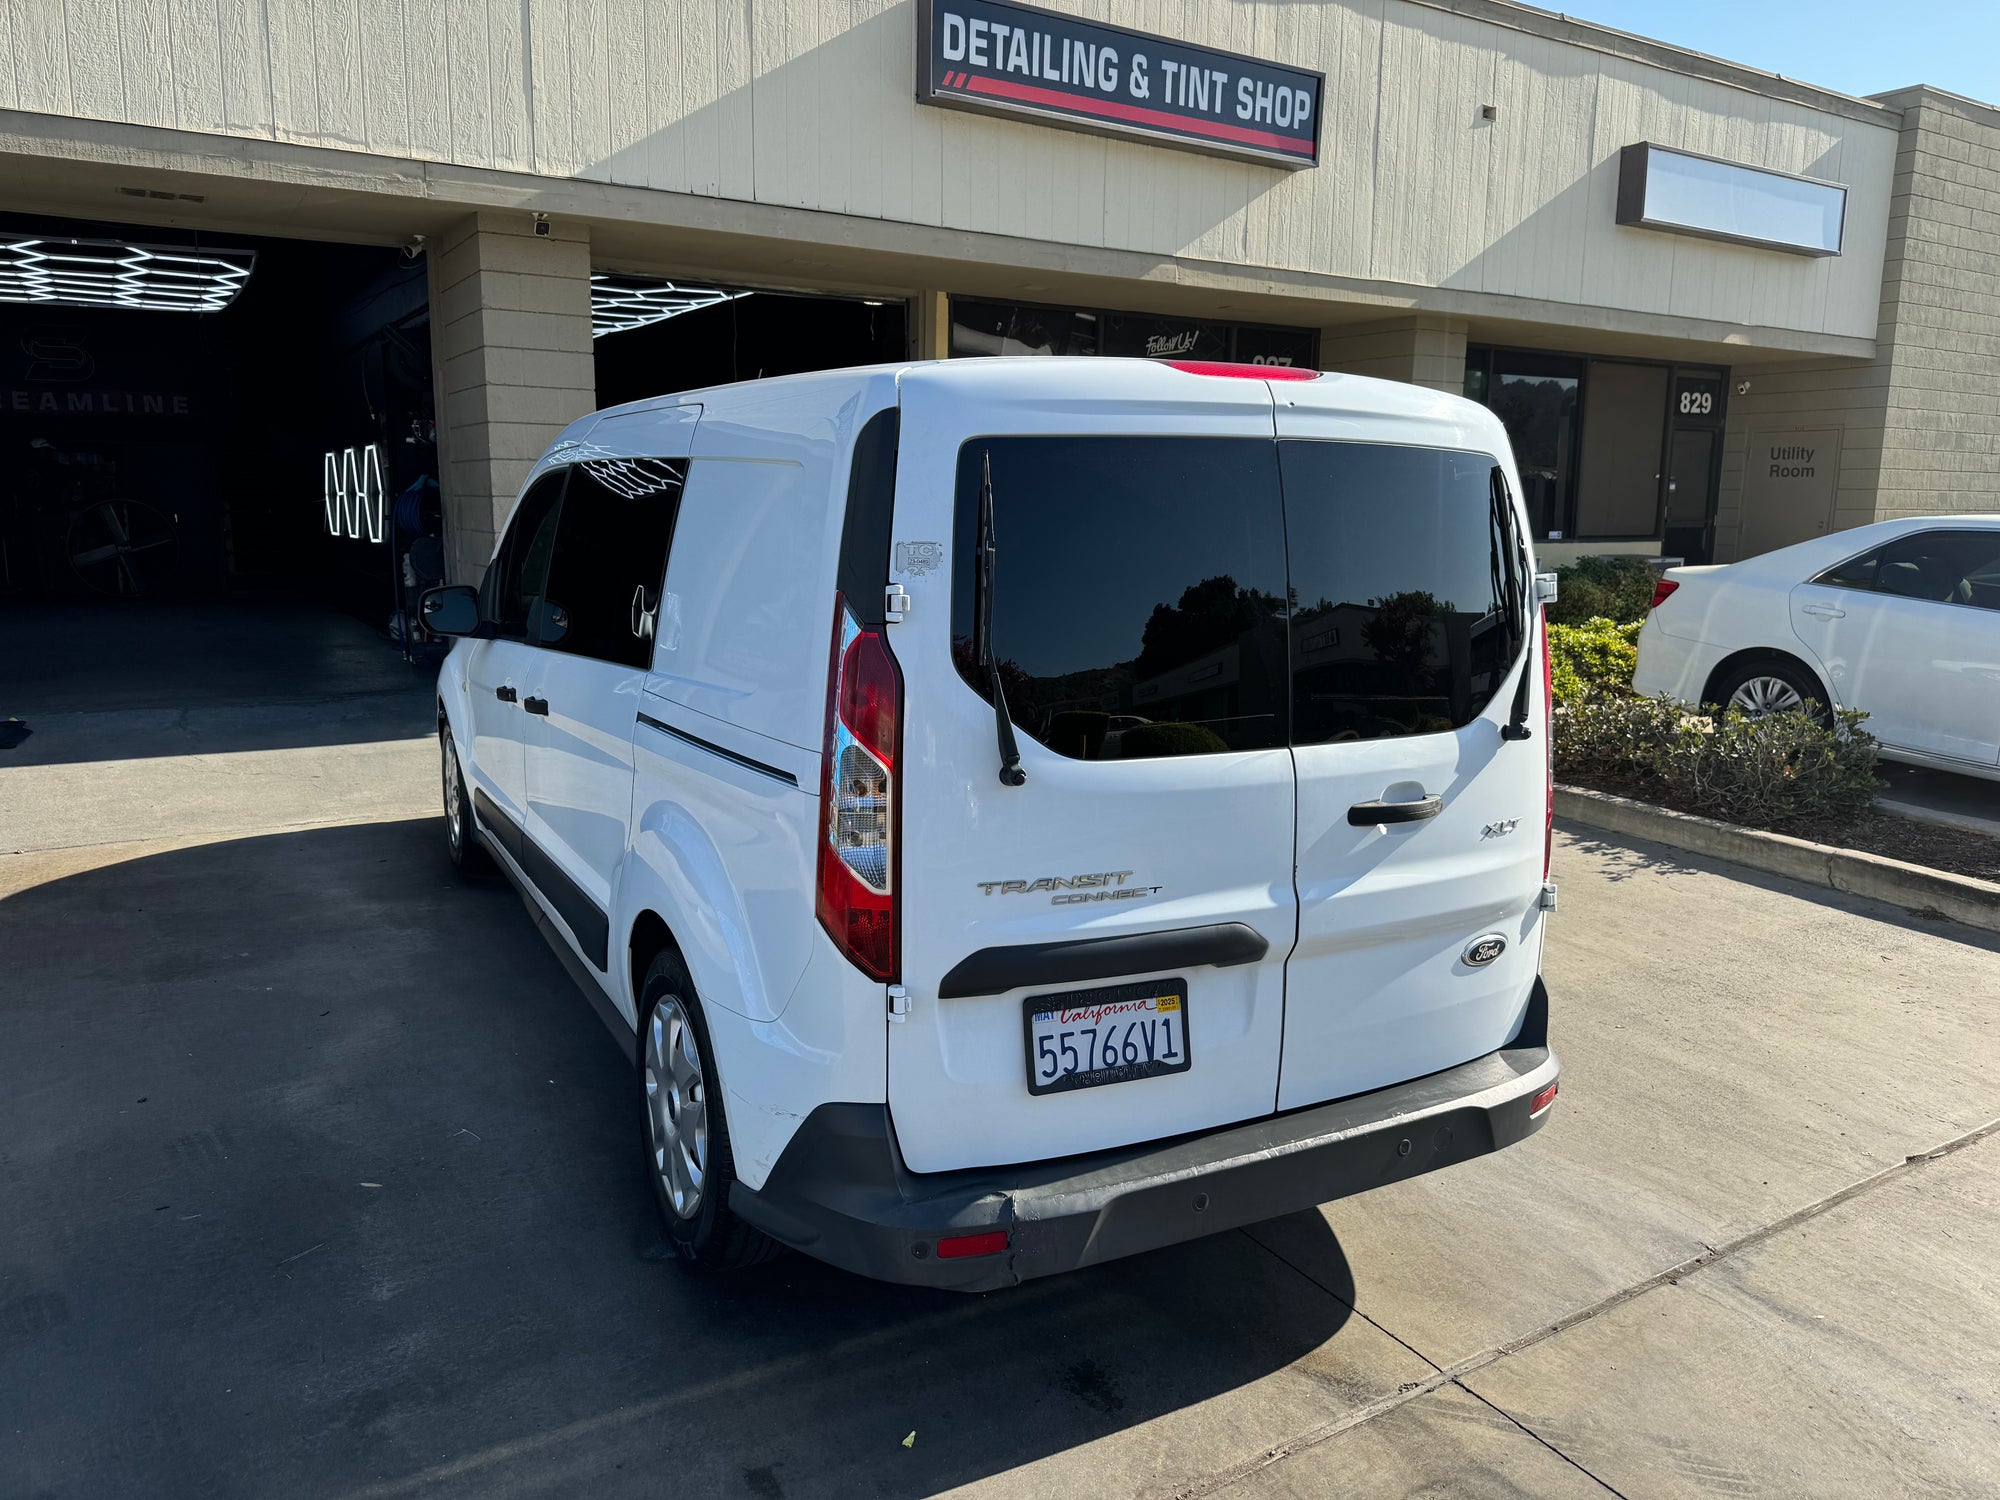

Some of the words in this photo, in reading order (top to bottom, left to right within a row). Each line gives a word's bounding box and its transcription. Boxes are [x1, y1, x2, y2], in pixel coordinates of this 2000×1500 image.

[943, 12, 1119, 93] DETAILING
[1129, 53, 1150, 99] &
[1161, 60, 1229, 114] TINT
[1236, 76, 1312, 130] SHOP
[0, 390, 190, 415] EAMLINE
[1680, 392, 1712, 414] 829
[1770, 446, 1815, 463] Utility
[1769, 464, 1815, 478] Room
[1480, 817, 1523, 842] XLT
[977, 870, 1136, 897] TRANSIT
[1051, 886, 1163, 906] CONNECT
[1475, 942, 1500, 961] Ford
[1034, 1010, 1055, 1022] MAY
[1060, 999, 1157, 1026] California
[1161, 997, 1176, 1007] 2025
[1039, 1018, 1178, 1078] 55766V1
